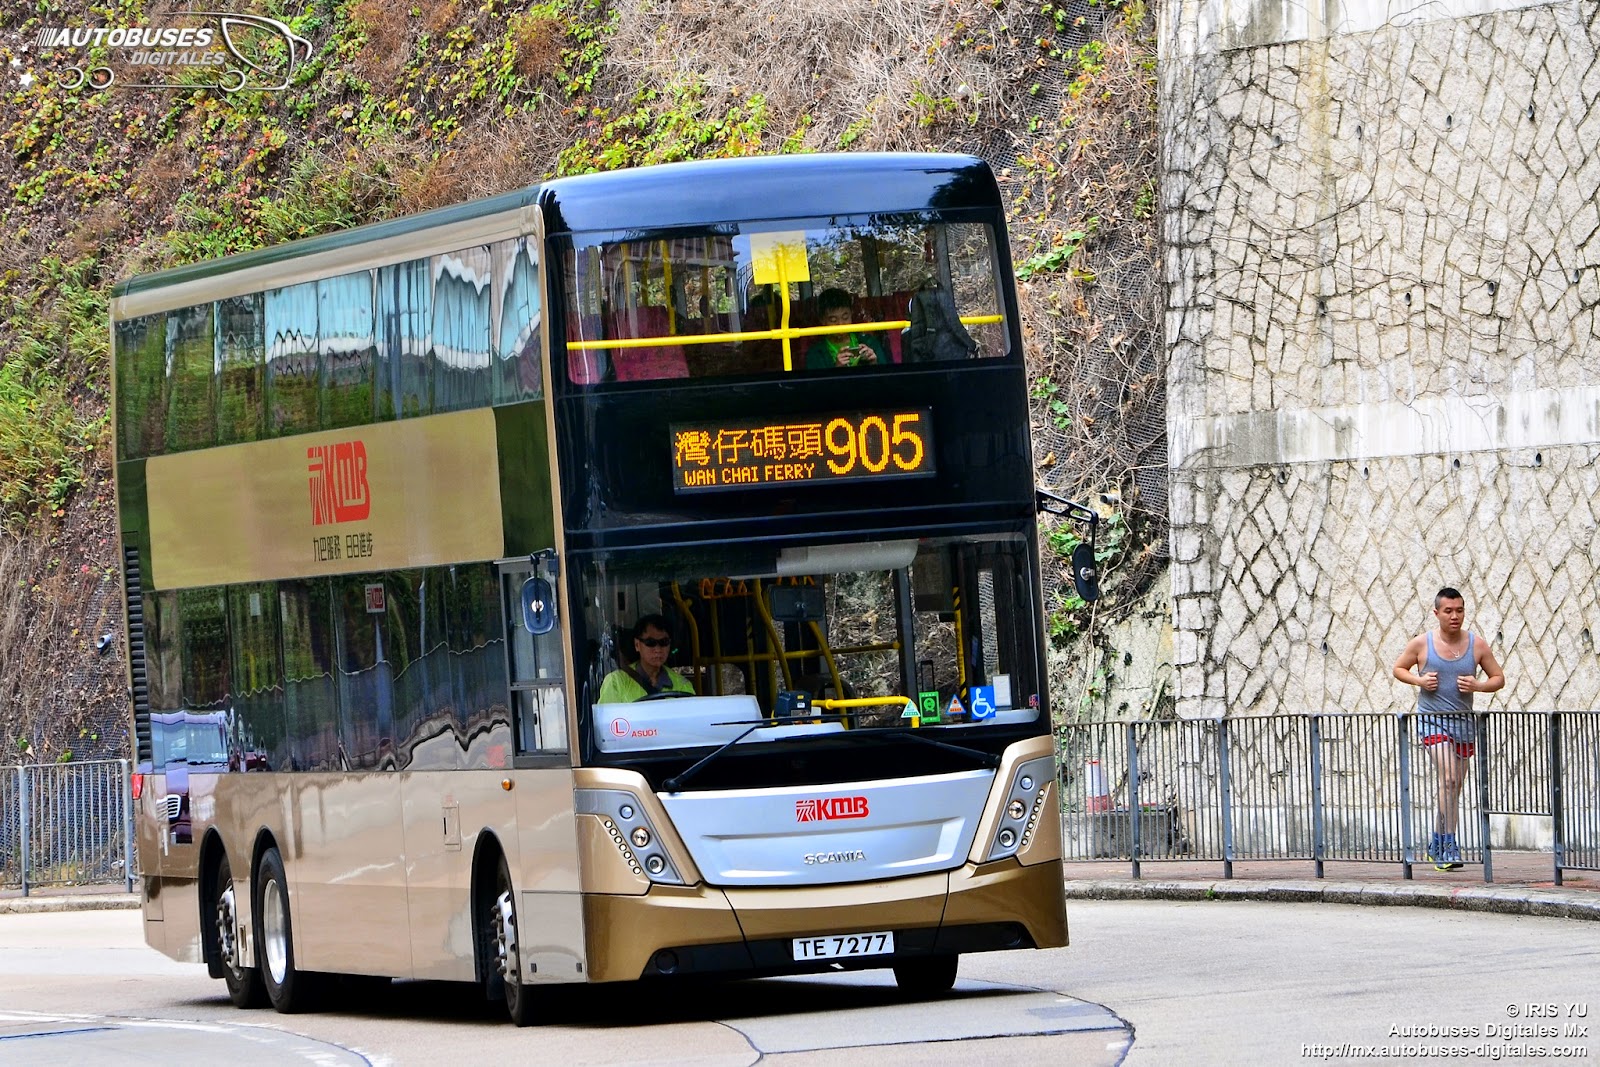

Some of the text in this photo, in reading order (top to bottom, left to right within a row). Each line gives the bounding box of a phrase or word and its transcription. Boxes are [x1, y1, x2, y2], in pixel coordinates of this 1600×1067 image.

[674, 413, 924, 475] 灣仔碼頭 905
[323, 440, 371, 524] KMB
[684, 462, 815, 486] WAN CHAI FERRY
[817, 796, 870, 821] KMB
[804, 849, 867, 866] SCANIA
[798, 933, 888, 957] TE 7277
